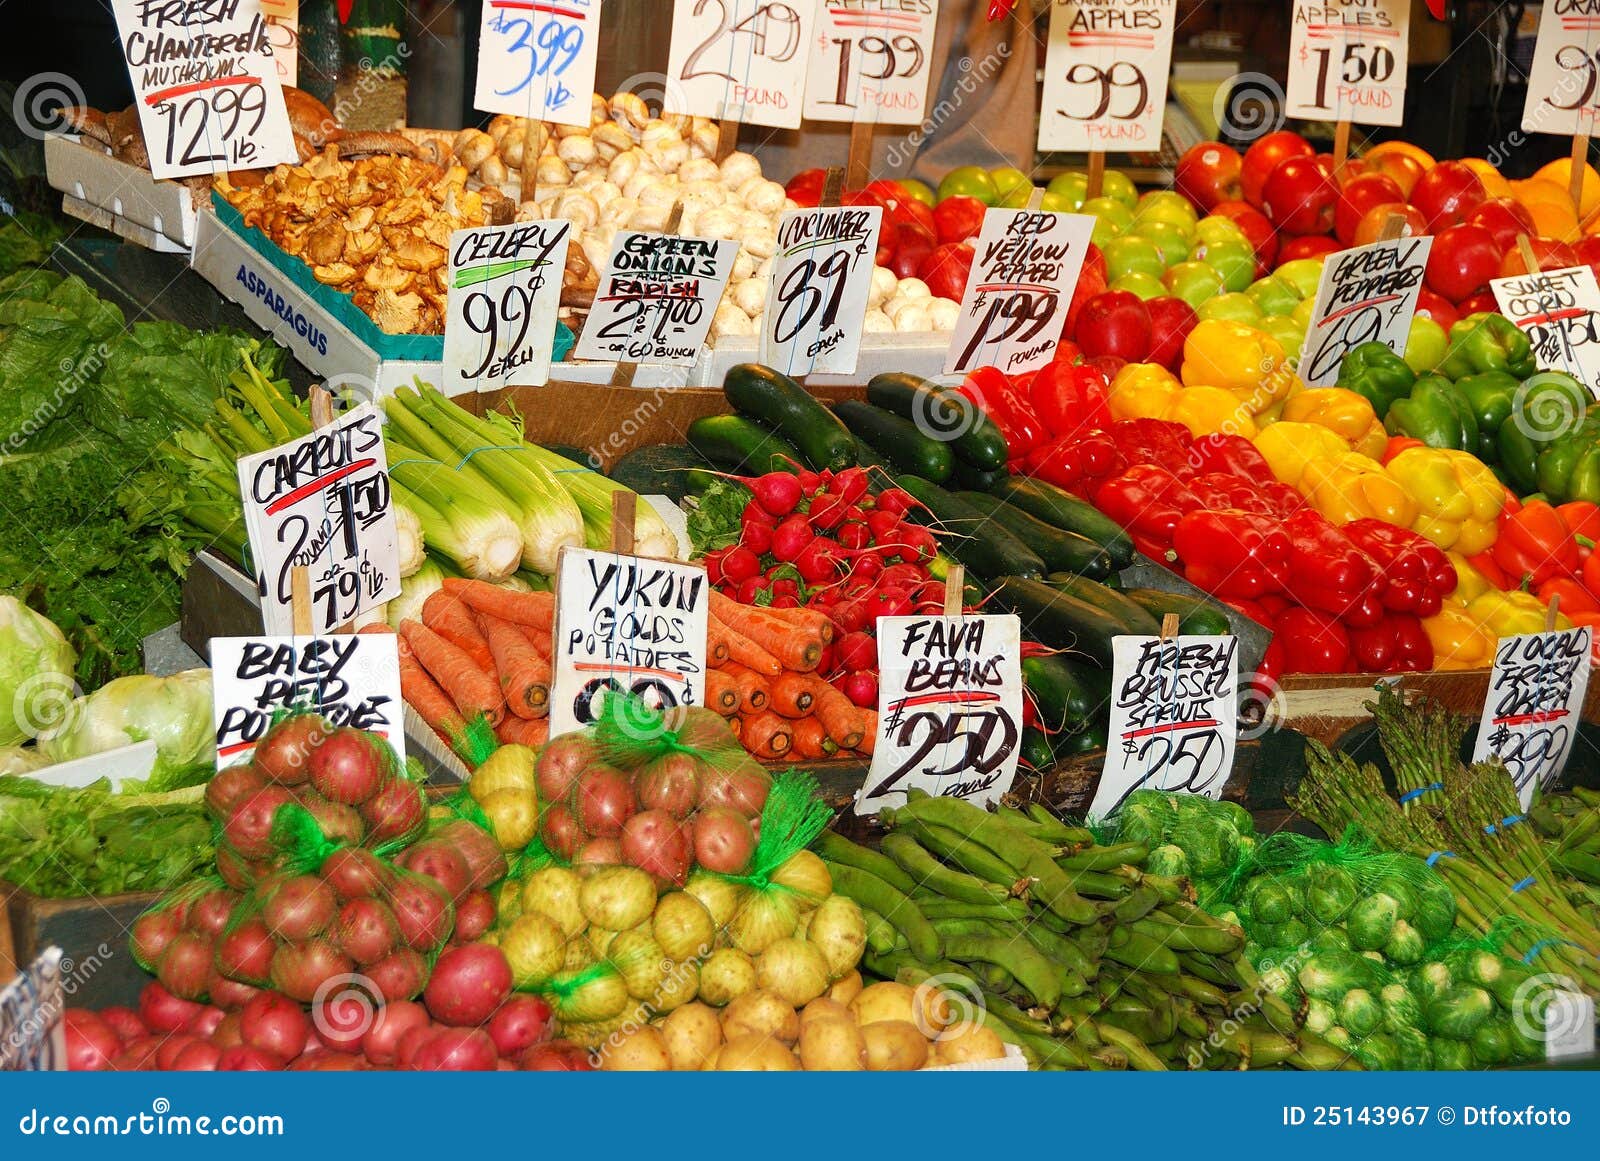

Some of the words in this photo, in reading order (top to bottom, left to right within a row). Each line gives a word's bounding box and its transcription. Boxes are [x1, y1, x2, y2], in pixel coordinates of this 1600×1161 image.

[135, 0, 239, 28] FRESH
[1069, 9, 1161, 32] APPLES
[1296, 5, 1393, 27] APPLES
[142, 57, 248, 90] MUSHROOMS
[734, 85, 788, 110] POUND
[861, 86, 919, 110] POUND
[1336, 85, 1392, 110] POUND
[1084, 123, 1146, 141] POUND
[1006, 212, 1057, 236] RED
[624, 234, 719, 259] GREEN
[1332, 239, 1421, 285] GREEN
[613, 250, 717, 276] ONIONS
[984, 262, 1063, 284] PEPPERS
[608, 278, 700, 297] RADISH
[1324, 265, 1424, 317] PEPPERS
[1501, 271, 1583, 296] SWEET
[236, 264, 329, 356] ASPARAGUS
[1509, 290, 1576, 321] CORN
[654, 347, 696, 358] BUNCH
[807, 329, 845, 358] EACH
[1006, 340, 1056, 372] POUND
[488, 346, 534, 378] EACH
[253, 413, 380, 504] CARROTS
[587, 558, 703, 613] YUKON
[593, 606, 684, 644] GOLDS
[902, 619, 985, 658] FAVA
[236, 635, 361, 683] BABY
[568, 628, 700, 673] POTATOES
[1135, 636, 1238, 675] FRESH
[904, 655, 1005, 692] BEANS
[1117, 667, 1231, 708] BRUSSEL
[1494, 655, 1581, 690] FRESH
[254, 675, 350, 709] RED
[1495, 681, 1572, 718] OKRA
[1125, 697, 1214, 728] SPROUTS
